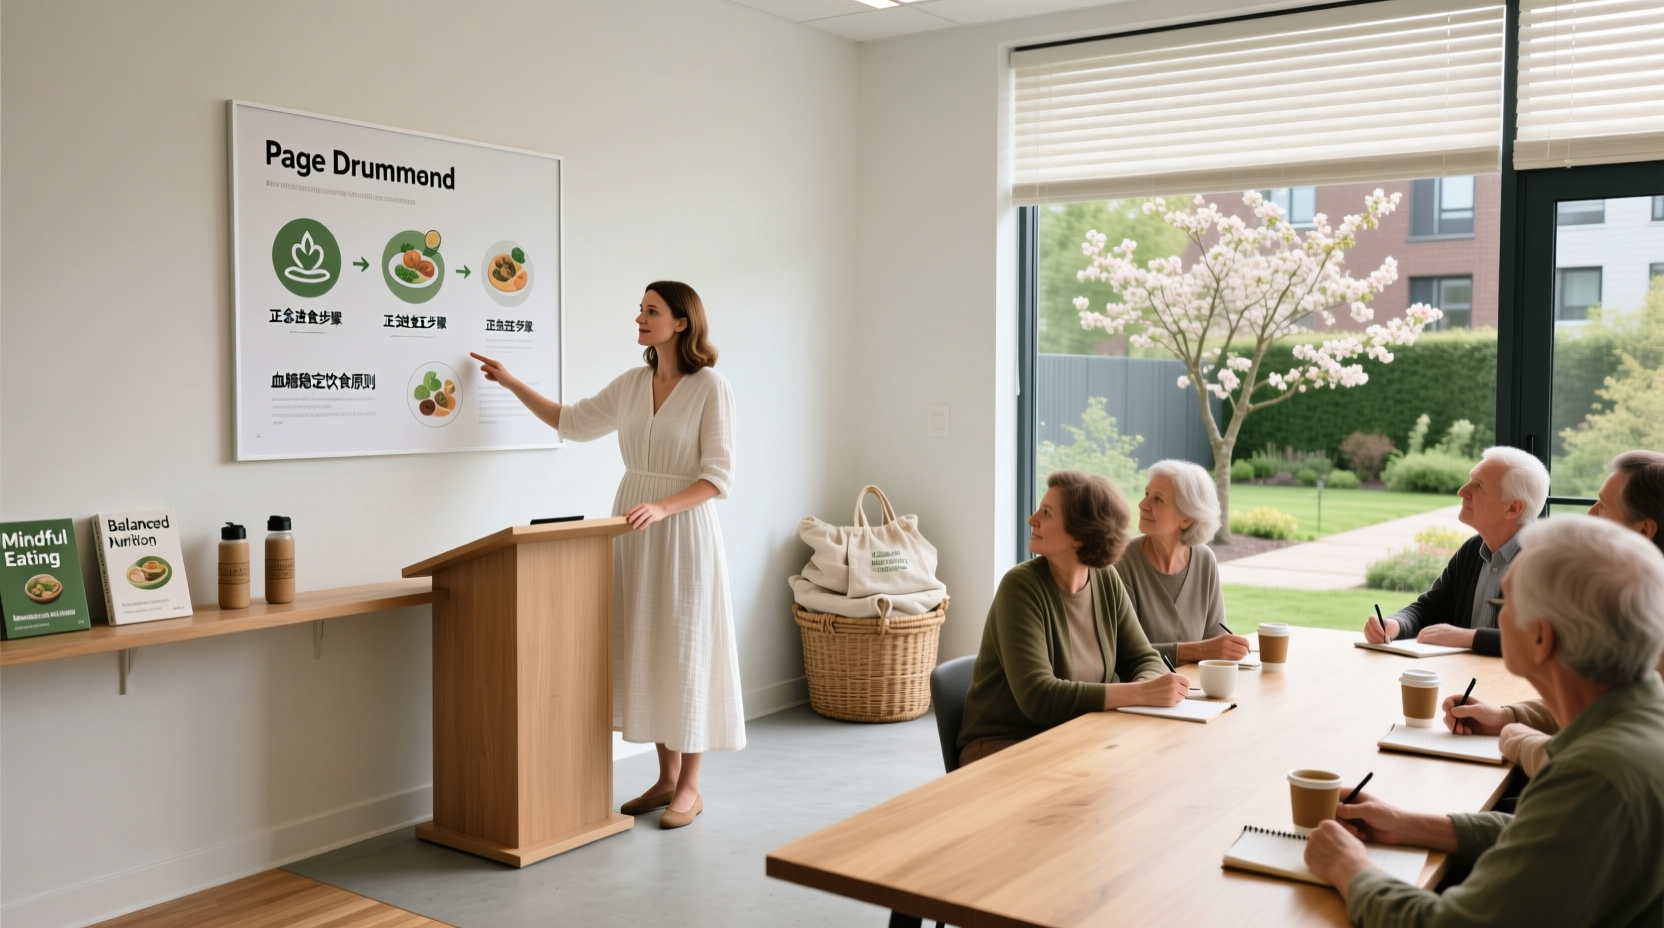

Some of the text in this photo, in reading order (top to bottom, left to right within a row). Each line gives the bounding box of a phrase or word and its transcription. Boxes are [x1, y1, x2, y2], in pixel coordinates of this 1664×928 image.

[265, 139, 326, 177] Page
[108, 514, 170, 532] Balanced
[2, 528, 68, 549] Mindful
[4, 550, 61, 568] Eating
